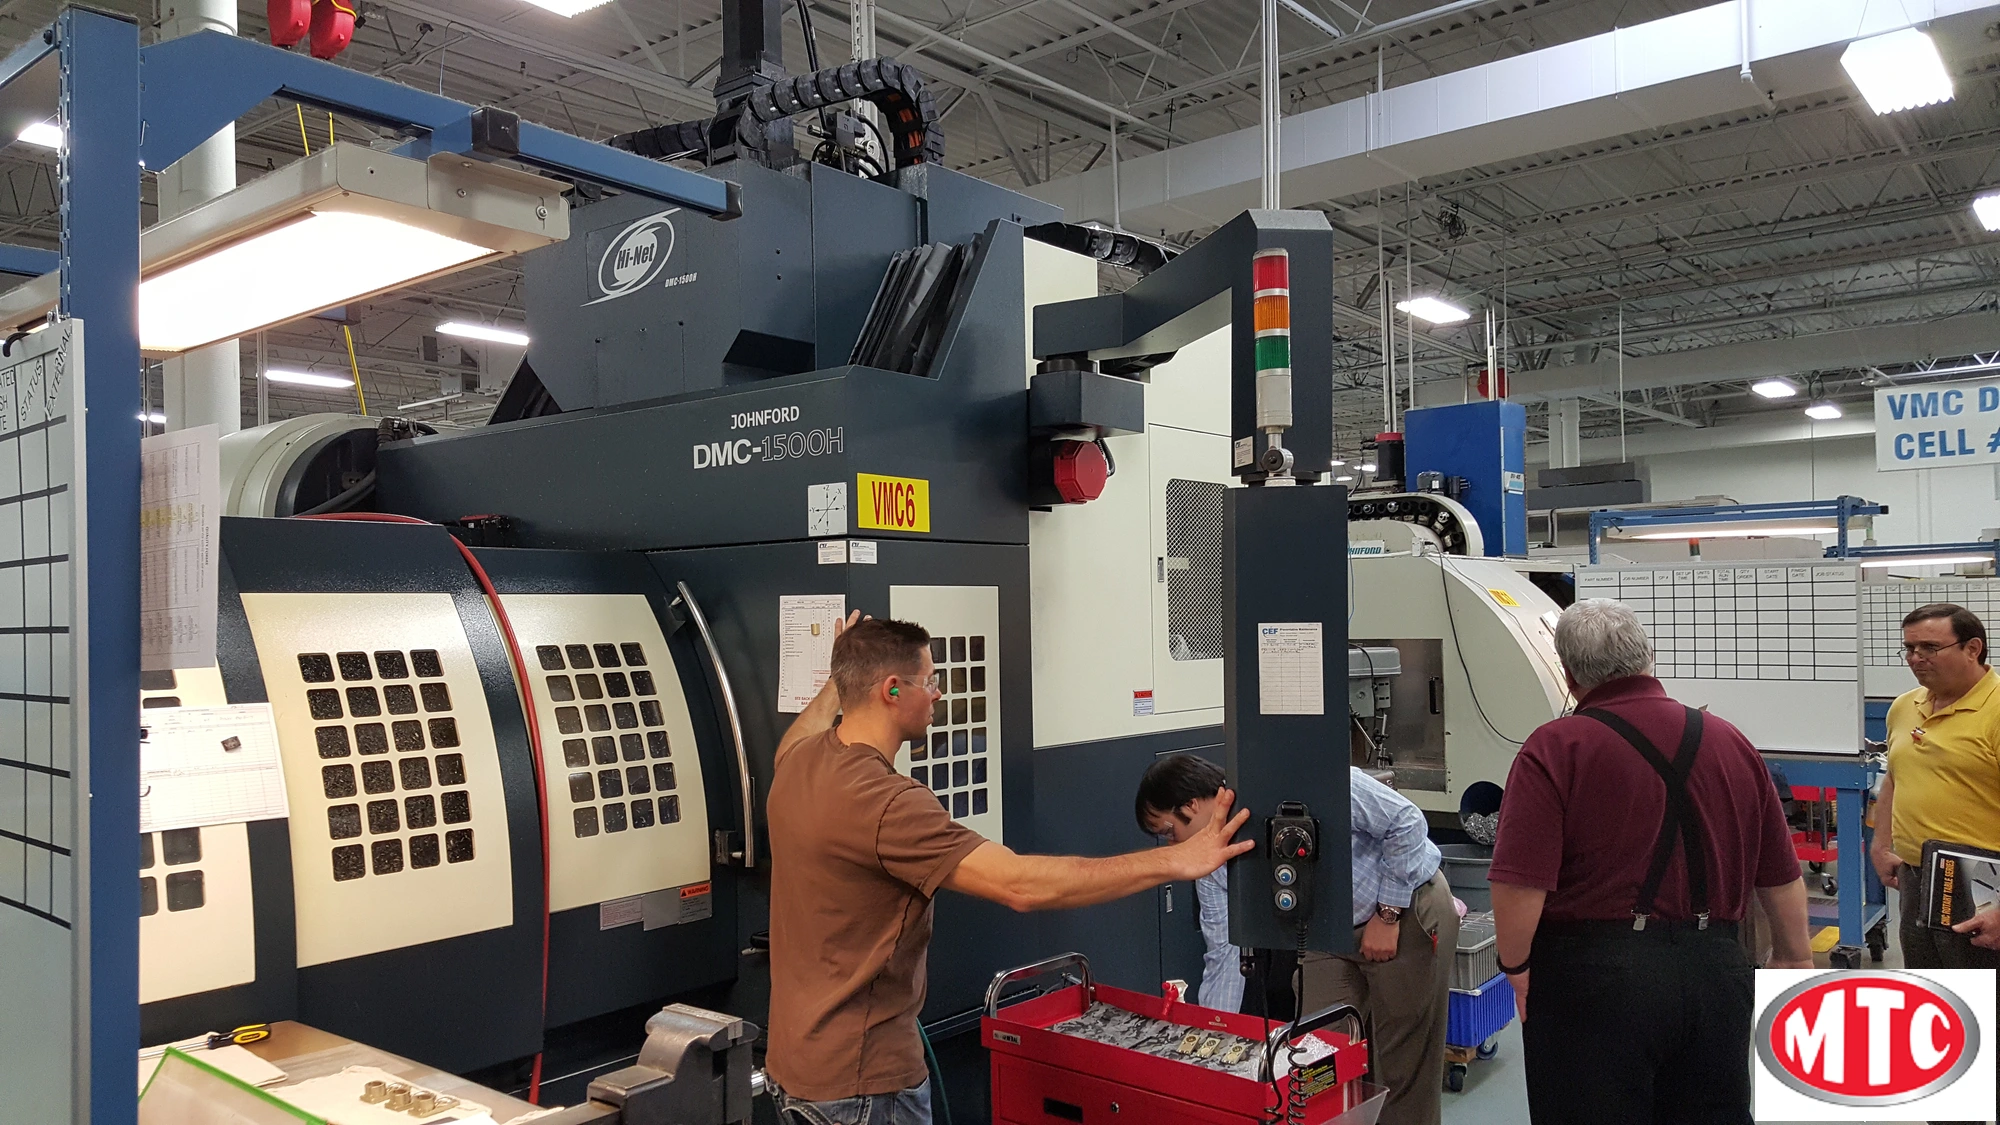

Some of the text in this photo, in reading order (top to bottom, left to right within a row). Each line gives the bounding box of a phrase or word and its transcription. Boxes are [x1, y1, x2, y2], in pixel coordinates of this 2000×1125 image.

[616, 243, 656, 270] Hi-Net
[664, 272, 698, 288] DMC-1500H
[46, 324, 73, 417] EXTERNAL
[20, 360, 43, 421] STATUS
[730, 405, 800, 430] JOHNFORD
[1886, 389, 1965, 420] VMC
[693, 426, 844, 470] DMC-1500H
[1894, 428, 1976, 461] CELL
[871, 480, 916, 528] VMC6
[1262, 627, 1279, 635] CEF
[687, 885, 709, 896] WARNING
[1943, 877, 1953, 894] TABLE
[1941, 893, 1952, 914] ROTARY
